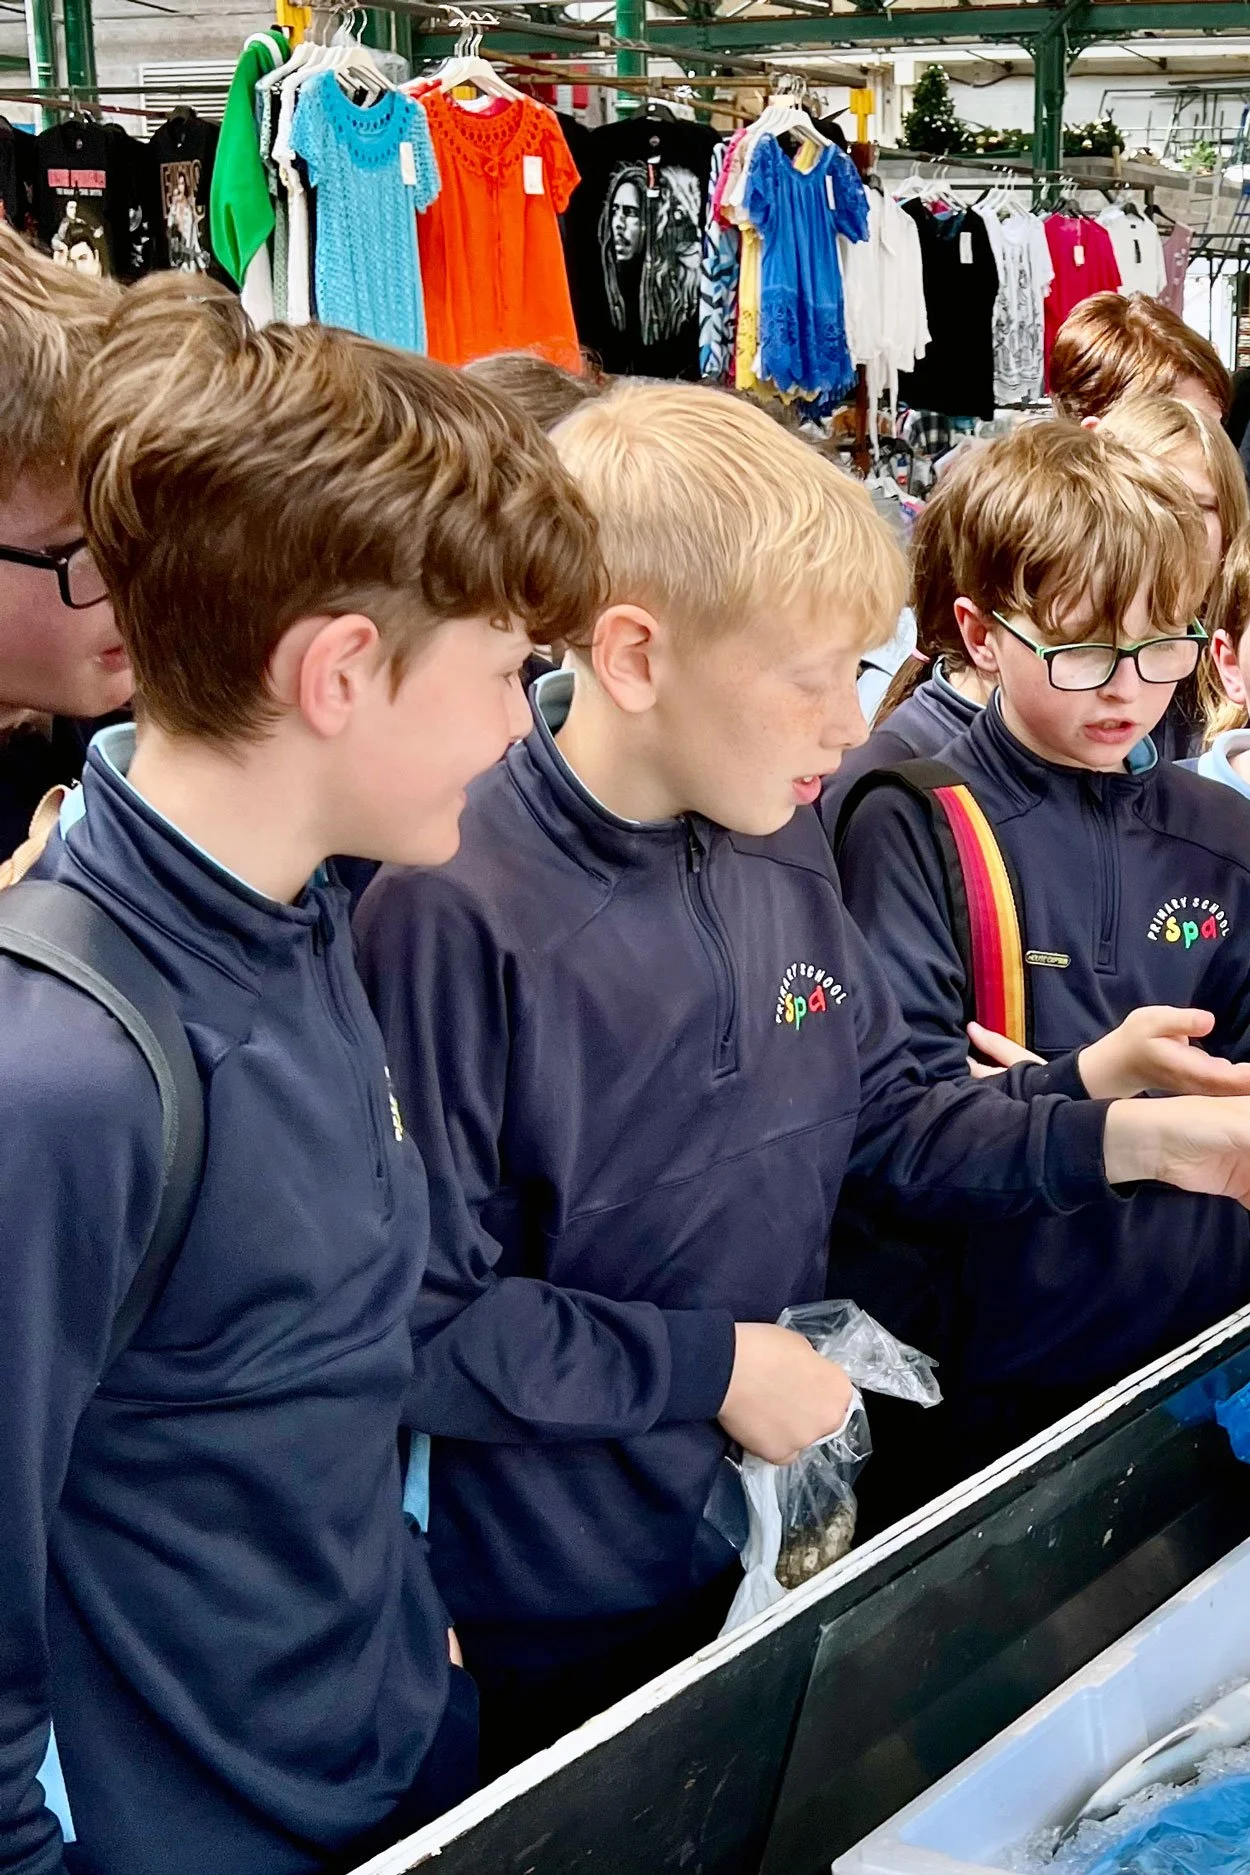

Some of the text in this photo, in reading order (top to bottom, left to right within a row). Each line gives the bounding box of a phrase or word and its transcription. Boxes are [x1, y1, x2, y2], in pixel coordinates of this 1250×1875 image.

[1147, 896, 1230, 940] PRIMARY SCHOOL
[800, 963, 847, 1004] SCHOOL
